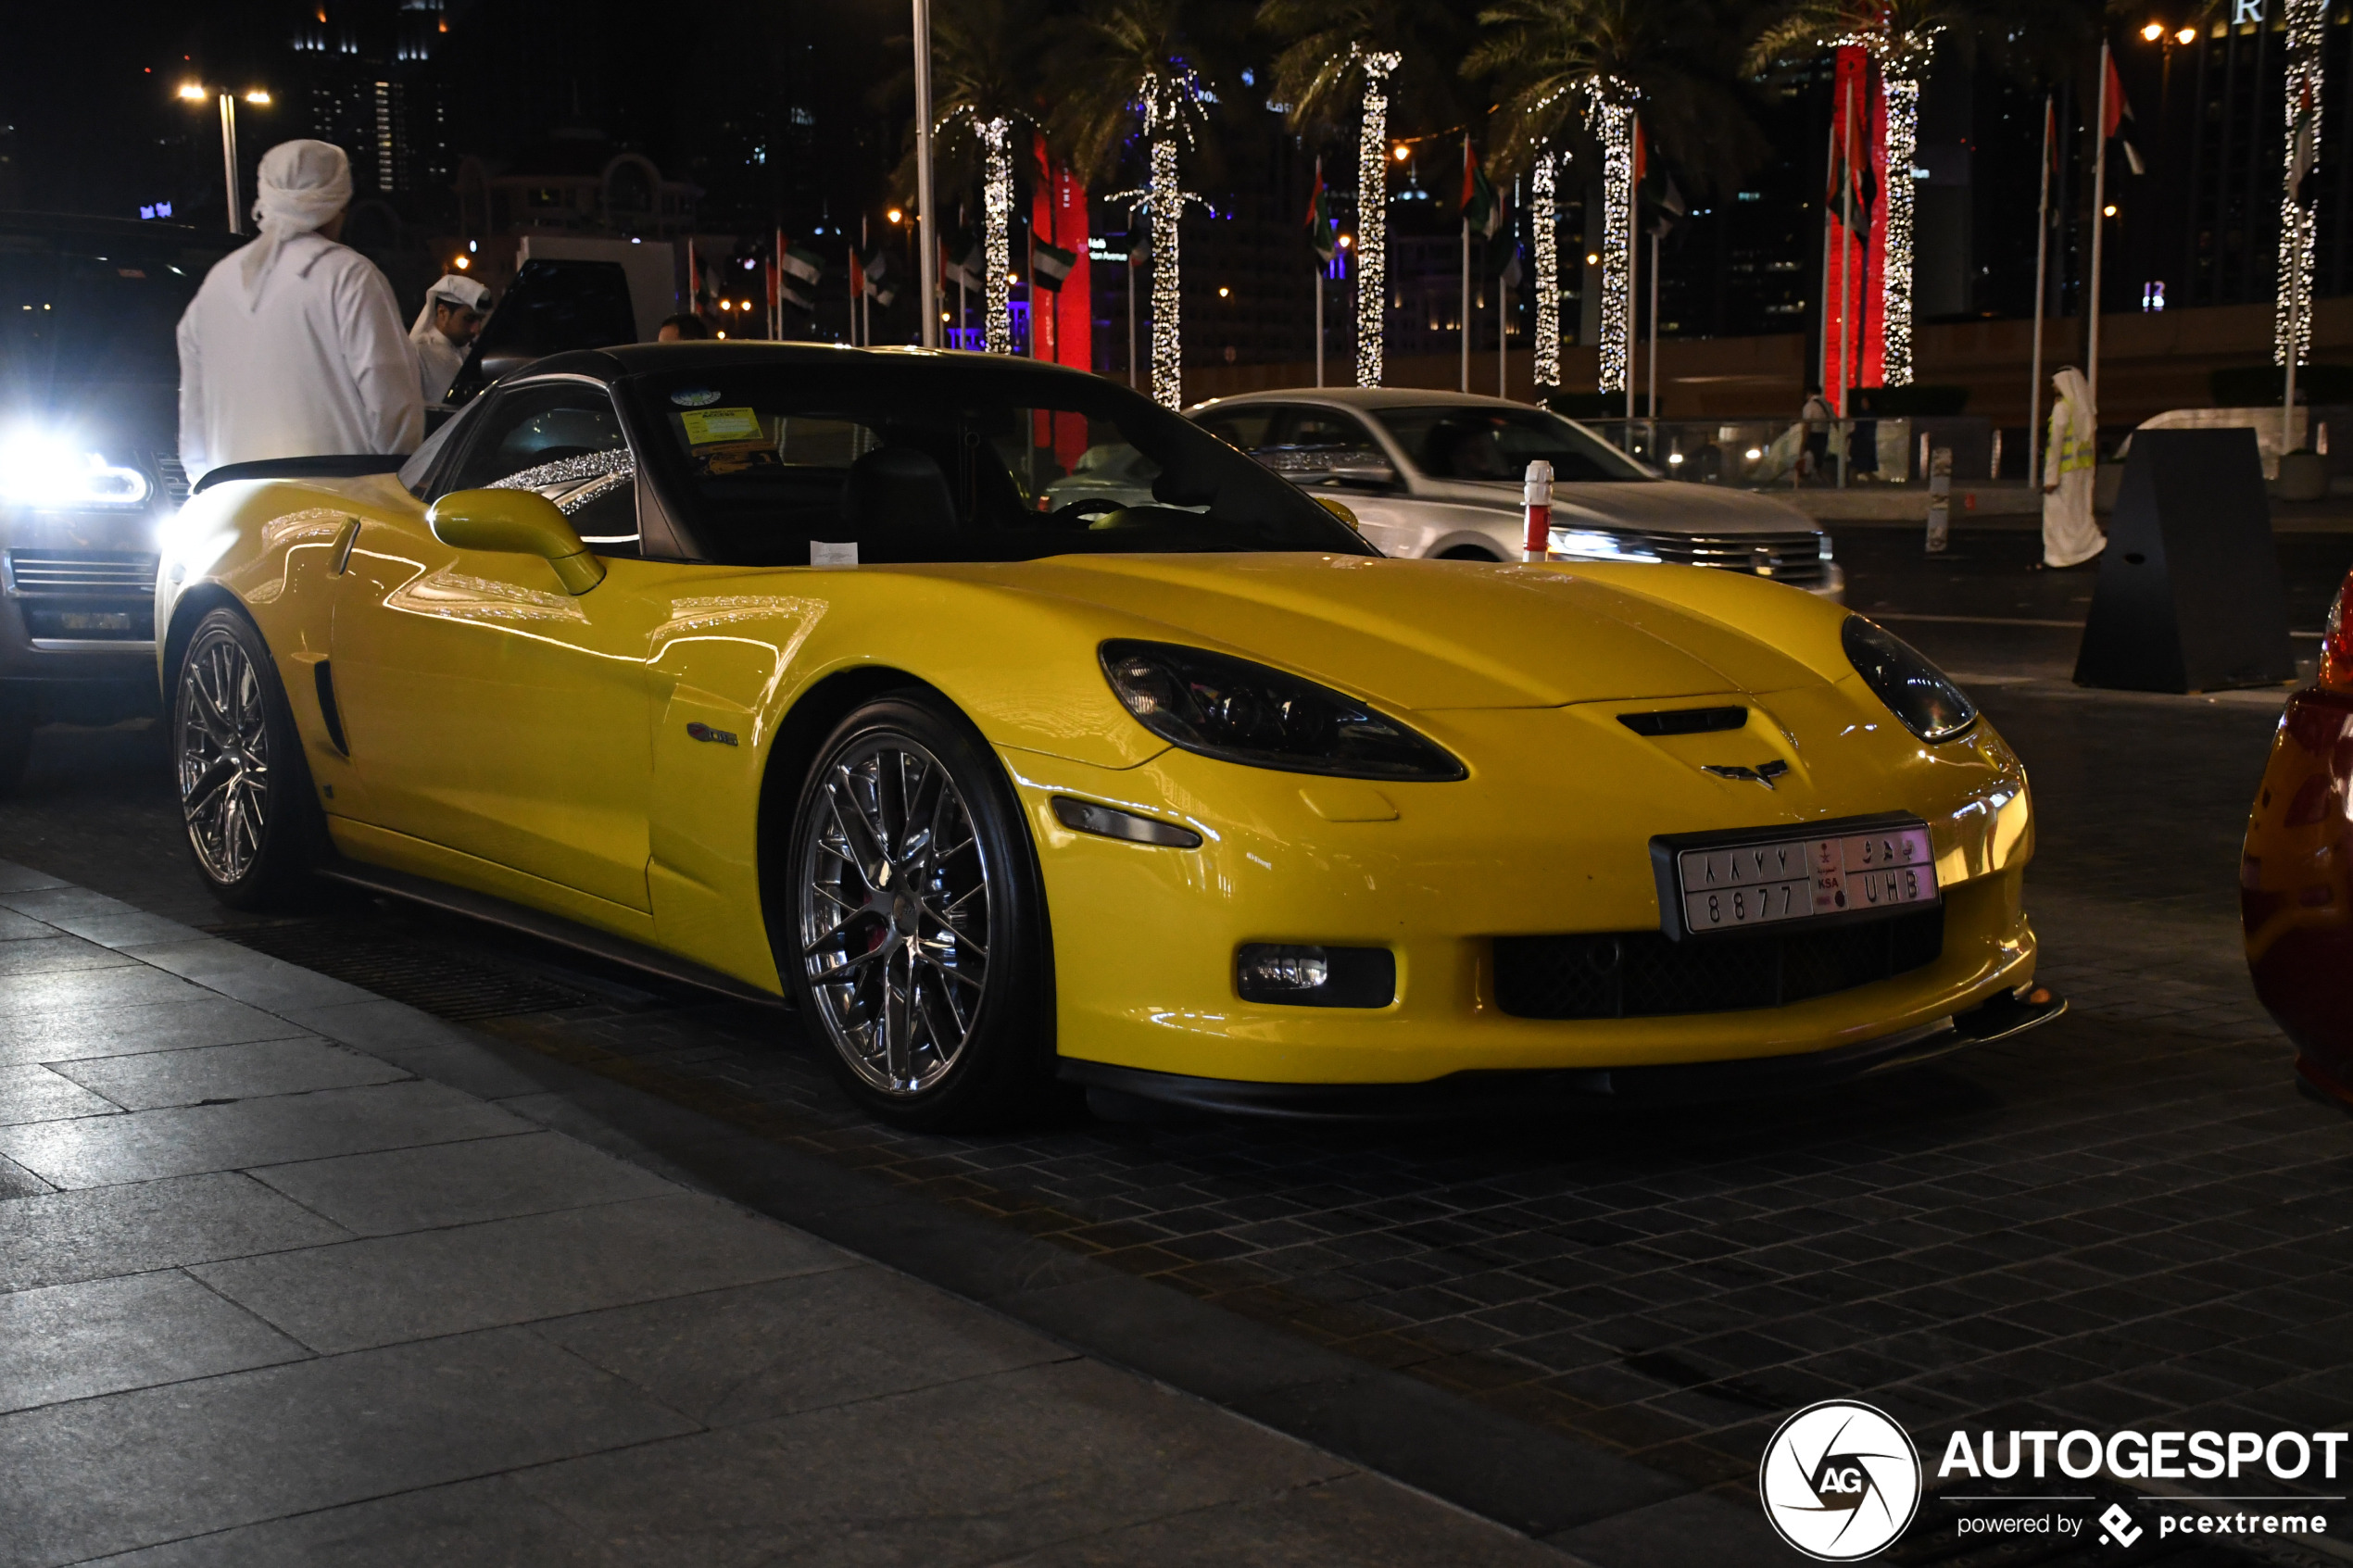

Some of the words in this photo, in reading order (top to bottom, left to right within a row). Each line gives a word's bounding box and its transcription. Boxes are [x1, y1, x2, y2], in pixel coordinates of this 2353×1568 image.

[1818, 877, 1839, 890] KSA
[1865, 870, 1918, 903] UHB
[1708, 885, 1791, 922] 8877
